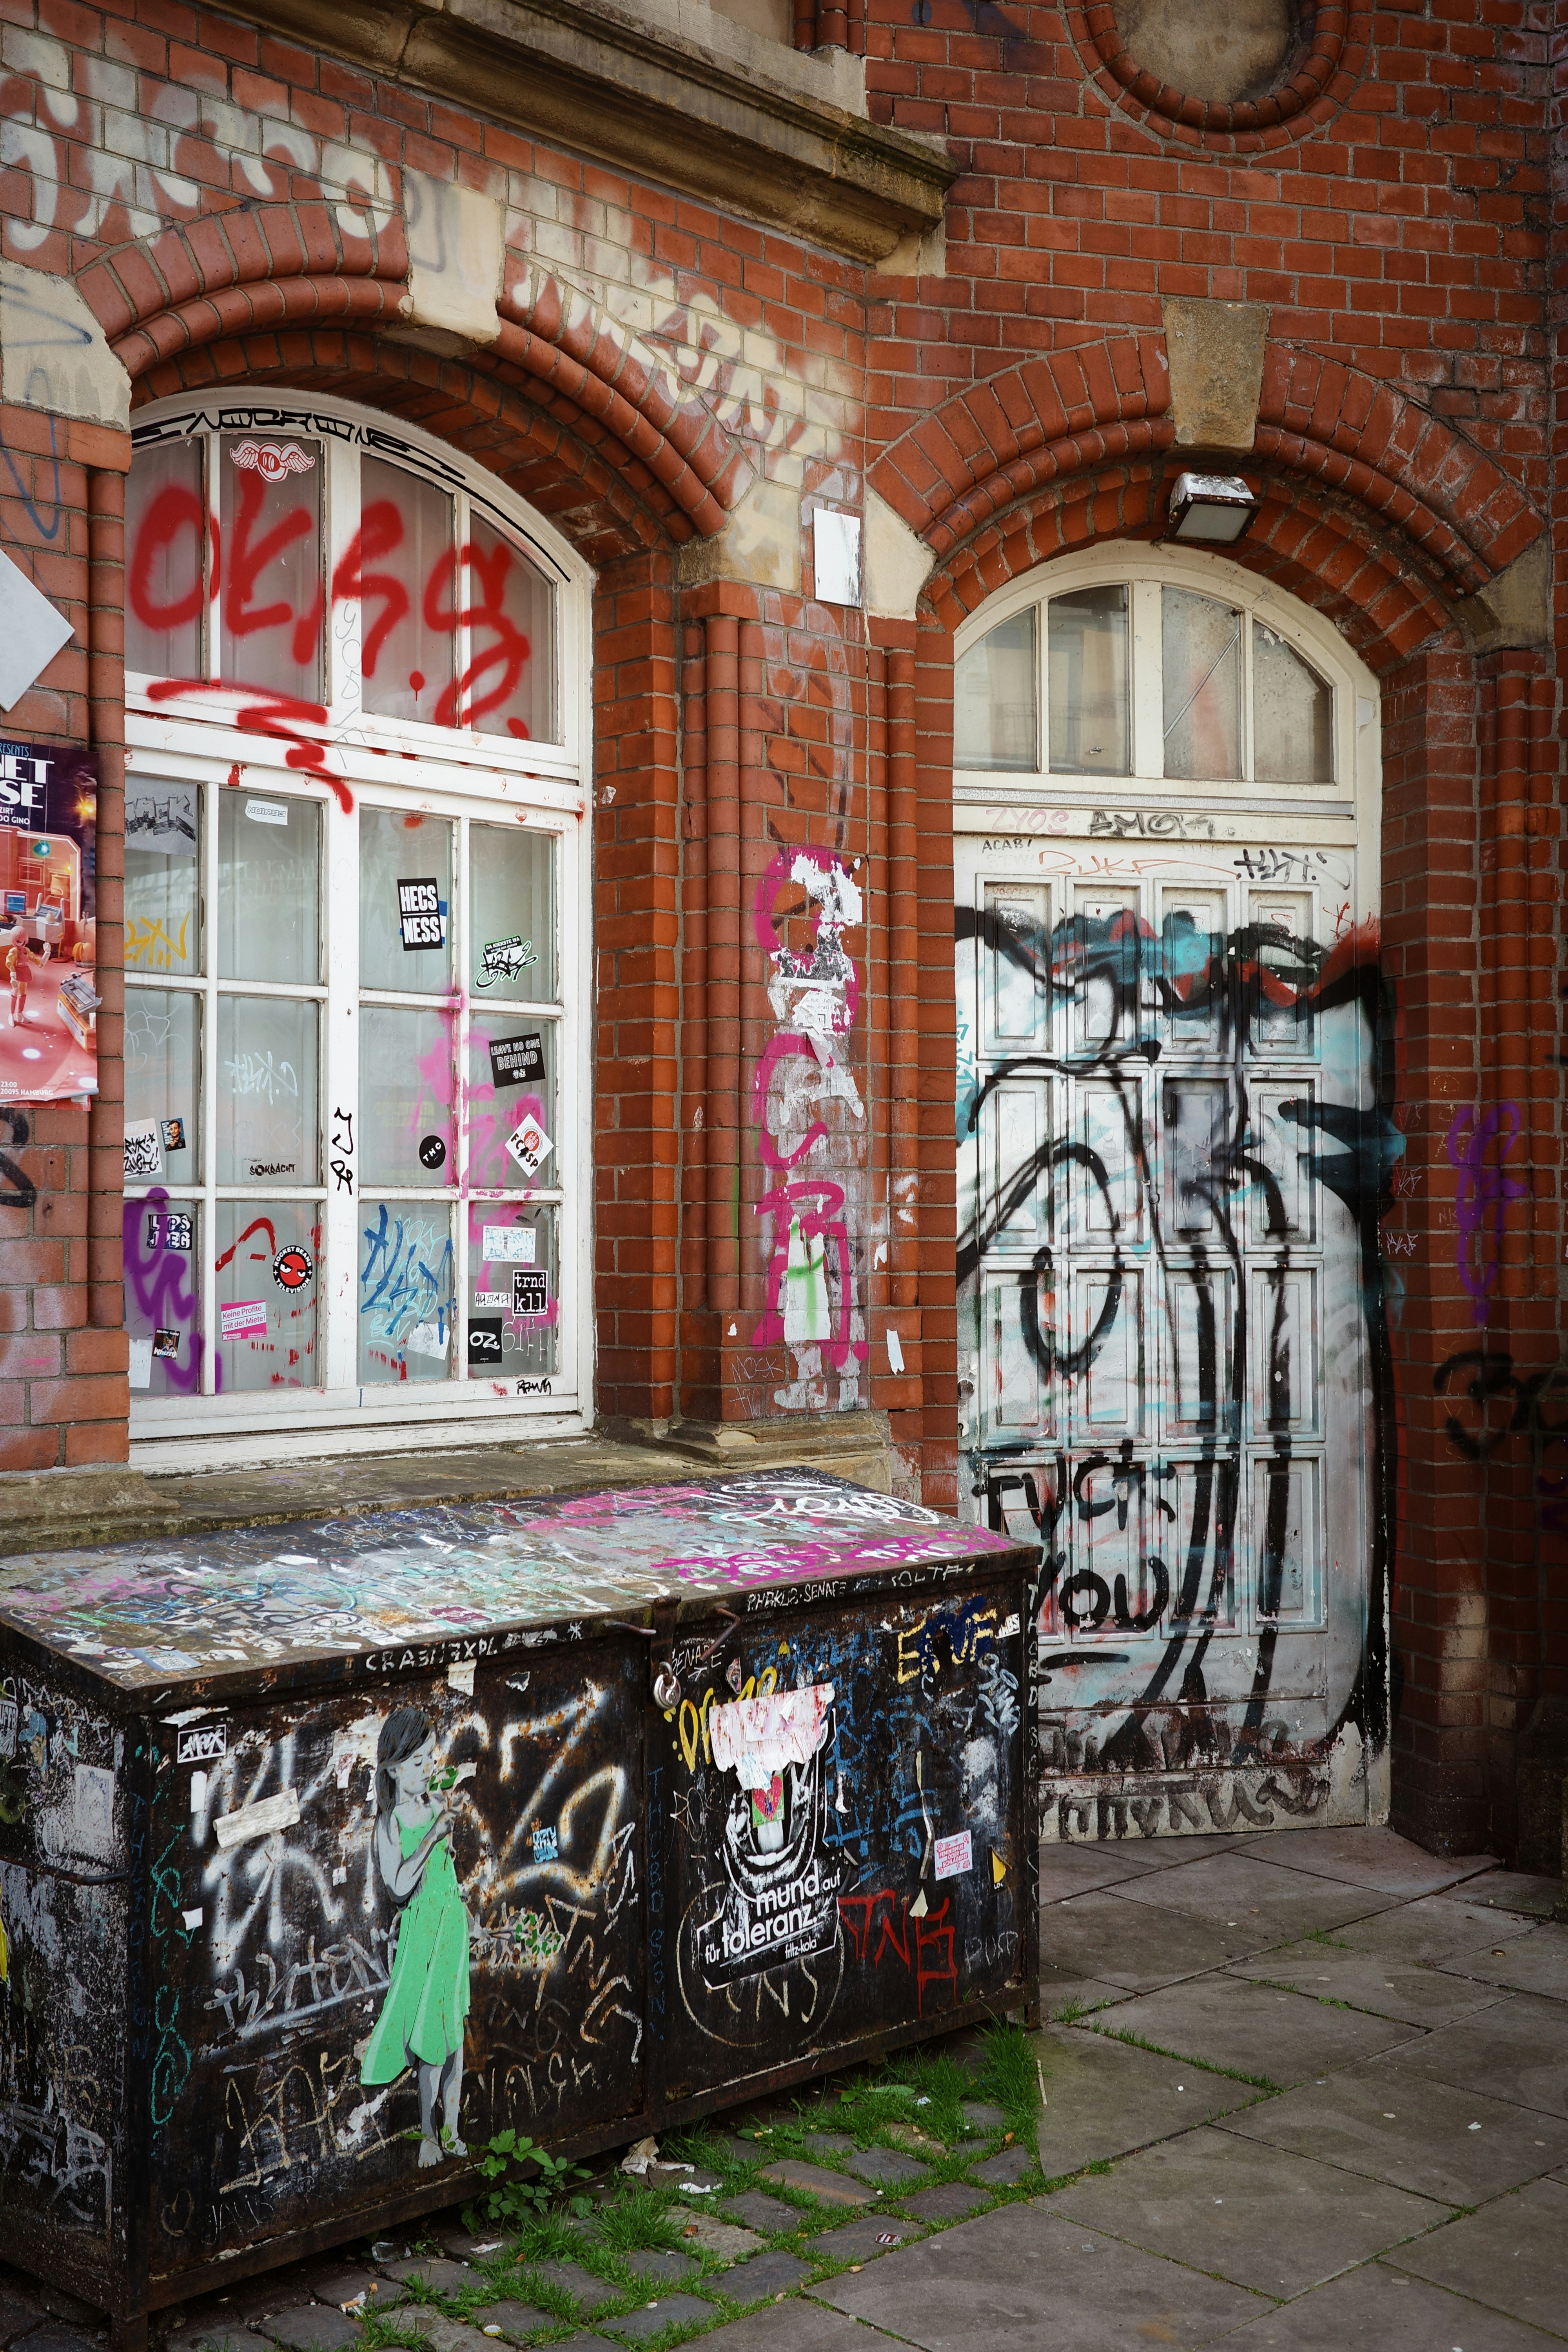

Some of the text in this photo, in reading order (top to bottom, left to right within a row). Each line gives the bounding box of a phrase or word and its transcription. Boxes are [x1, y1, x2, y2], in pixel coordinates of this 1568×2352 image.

[11, 817, 30, 825] GINO
[399, 885, 437, 912] HECS
[403, 917, 441, 944] NESS
[492, 939, 512, 948] KIEKSTE
[490, 1038, 540, 1056] LEAVE NO ONE
[497, 1051, 537, 1071] BEHIND
[423, 1142, 441, 1162] THC
[274, 1246, 312, 1267] ROCKET BEANS
[276, 1278, 310, 1294] TELEVISION
[515, 1273, 546, 1289] trnd
[515, 1292, 546, 1312] kll
[223, 1305, 262, 1319] Keine Profite
[234, 1319, 245, 1328] der
[246, 1315, 265, 1325] Miete!
[939, 1843, 964, 1858] FEMINISMUS
[947, 1851, 960, 1860] ODER
[756, 1859, 840, 1917] mund auf
[705, 1903, 818, 1965] für toleranz.
[784, 1935, 817, 1960] fritz-kola
